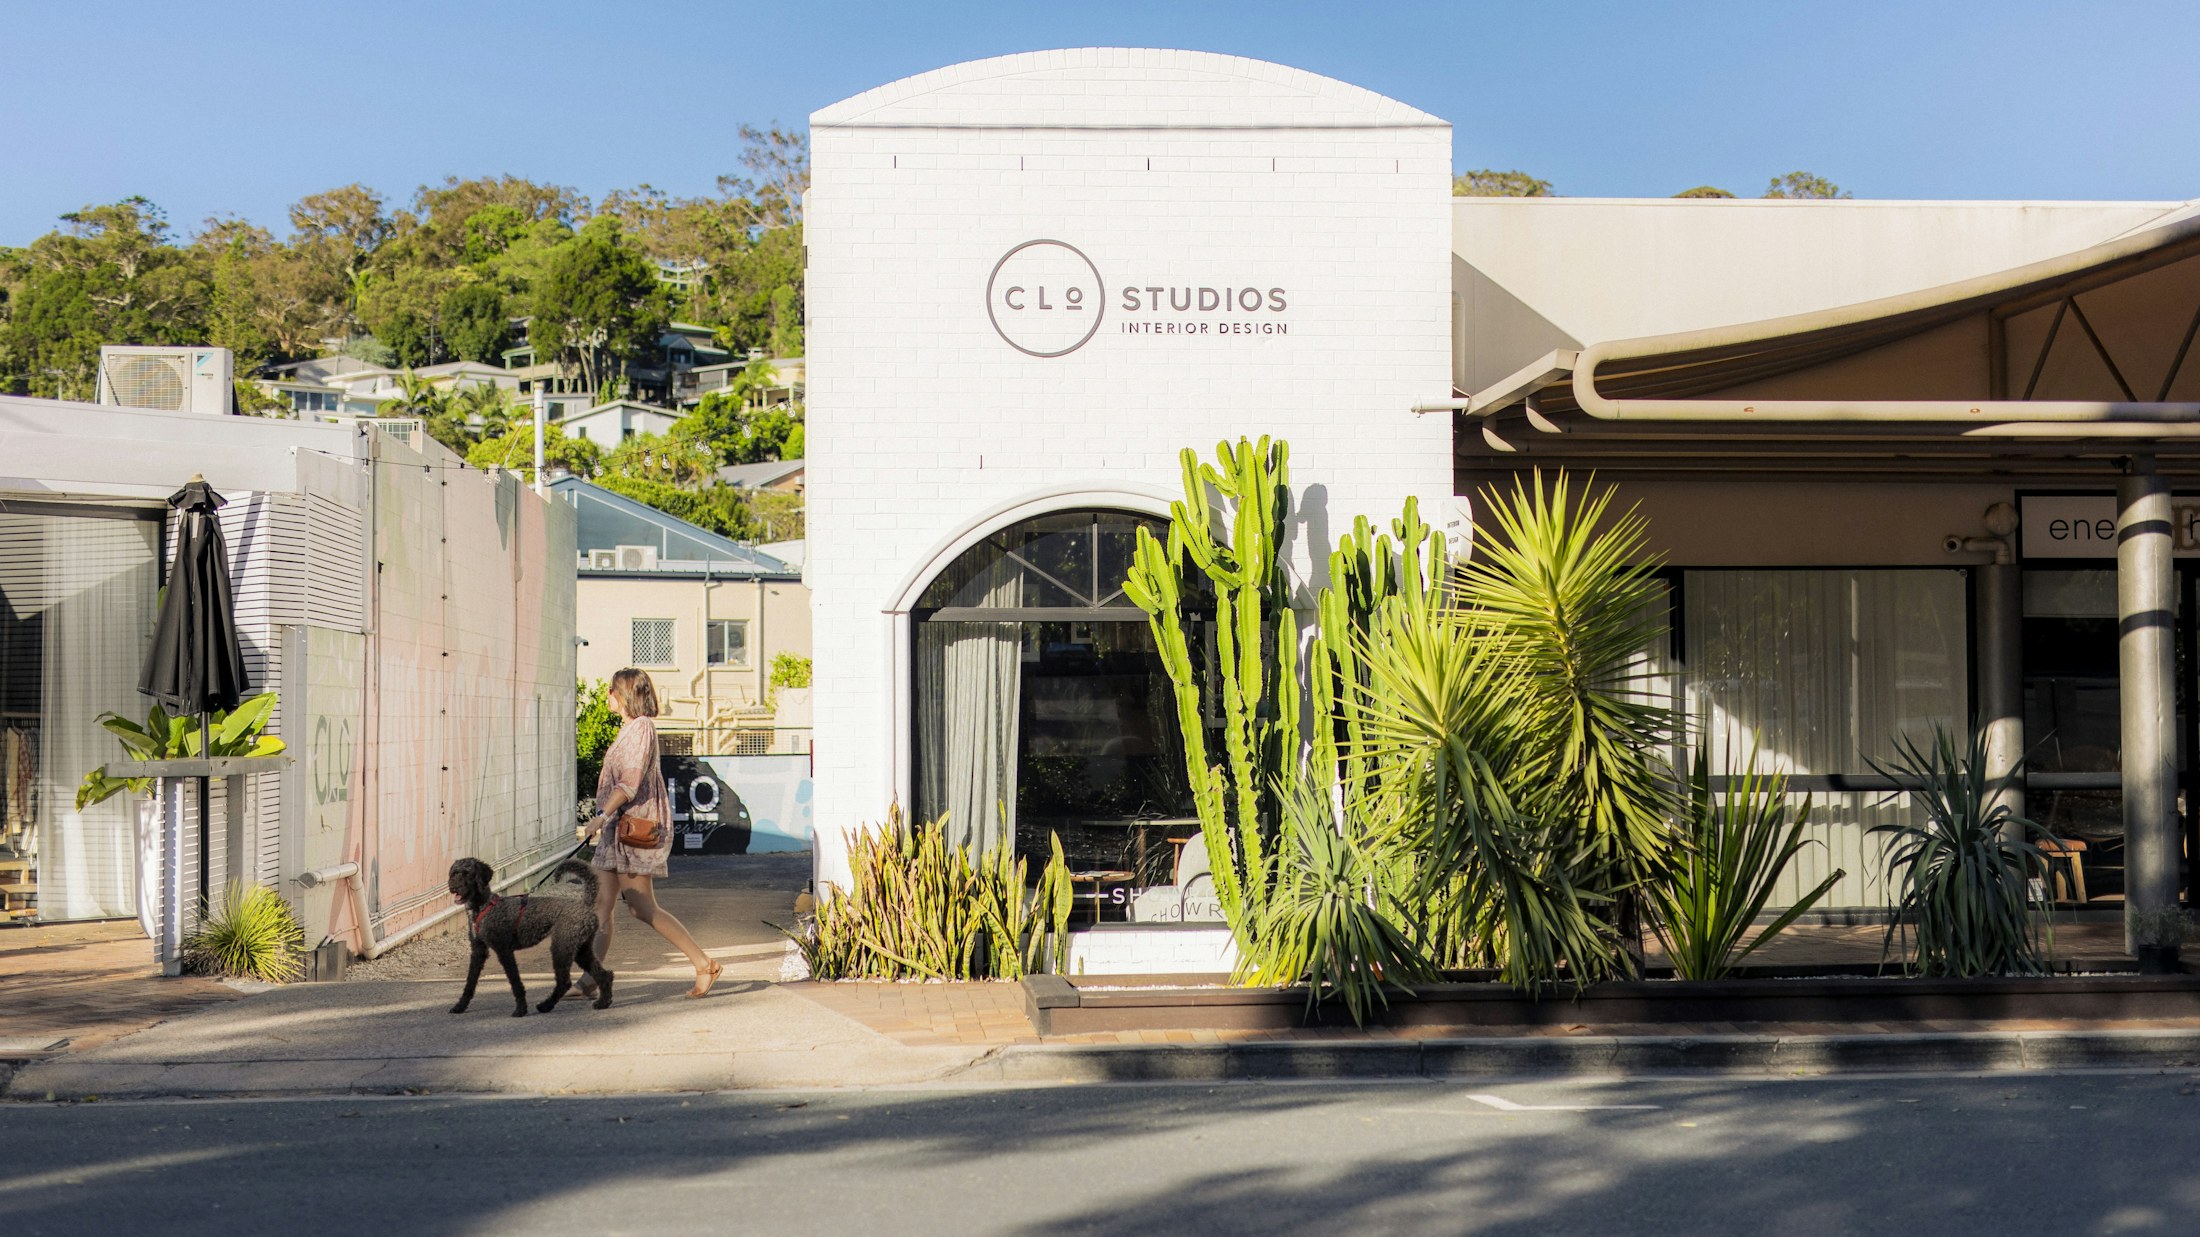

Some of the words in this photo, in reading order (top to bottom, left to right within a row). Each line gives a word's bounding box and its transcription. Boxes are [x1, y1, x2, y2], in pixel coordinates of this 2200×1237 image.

[1121, 286, 1288, 312] STUDIOS
[1121, 322, 1209, 334] INTERIOR
[1219, 322, 1288, 335] DESIGN
